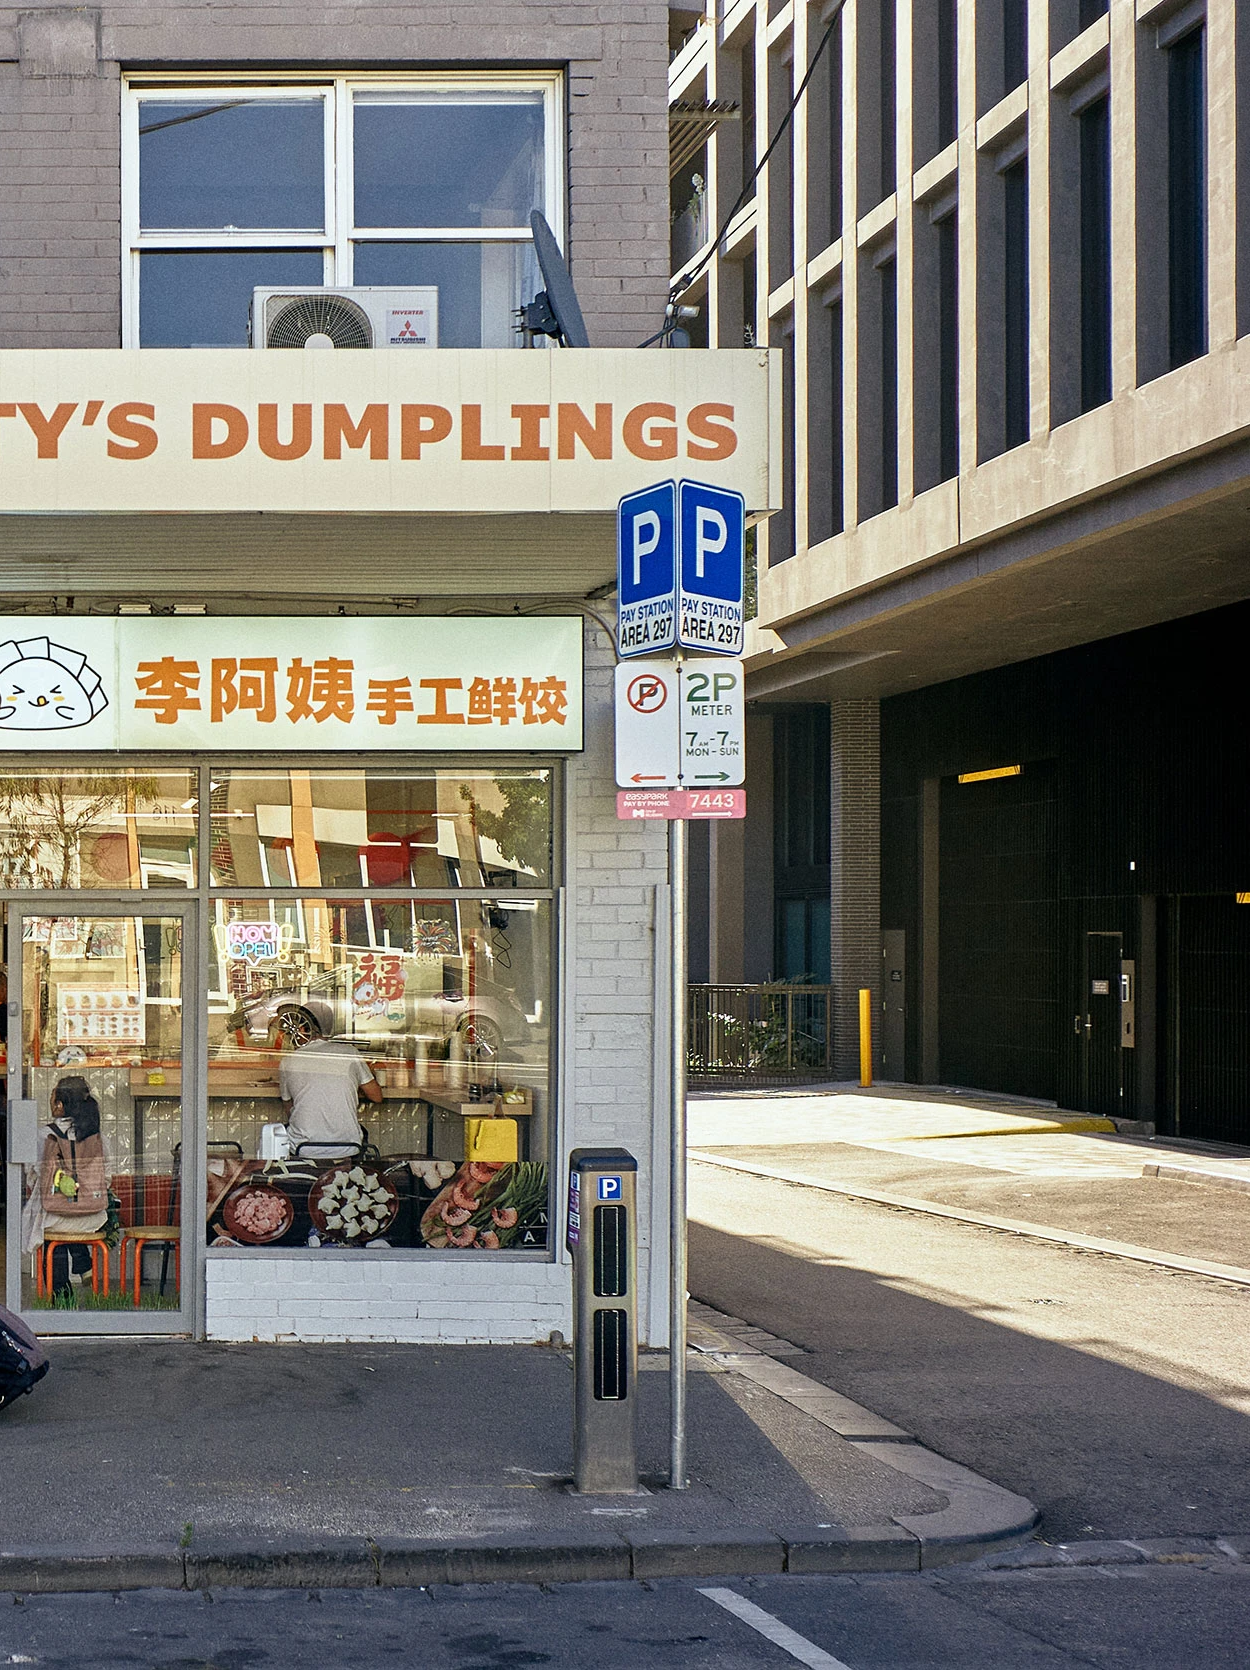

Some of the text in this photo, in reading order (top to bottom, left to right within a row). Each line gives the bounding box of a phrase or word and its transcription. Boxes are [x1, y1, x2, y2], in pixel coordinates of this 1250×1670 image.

[192, 401, 739, 461] DUMPLINGS
[633, 509, 661, 586] P
[696, 505, 728, 578] P
[621, 598, 674, 624] PAY STATION
[682, 597, 741, 622] PAY STATION
[621, 617, 672, 647] AREA 297
[682, 617, 741, 645] AREA 297
[134, 656, 568, 726] 李阿姨 手工鲜饺
[686, 672, 737, 702] 2P
[691, 704, 733, 716] METER
[690, 793, 734, 808] 7443
[230, 925, 277, 942] NOW
[230, 942, 277, 957] OPEN
[352, 953, 405, 1001] 福
[603, 1178, 618, 1198] P
